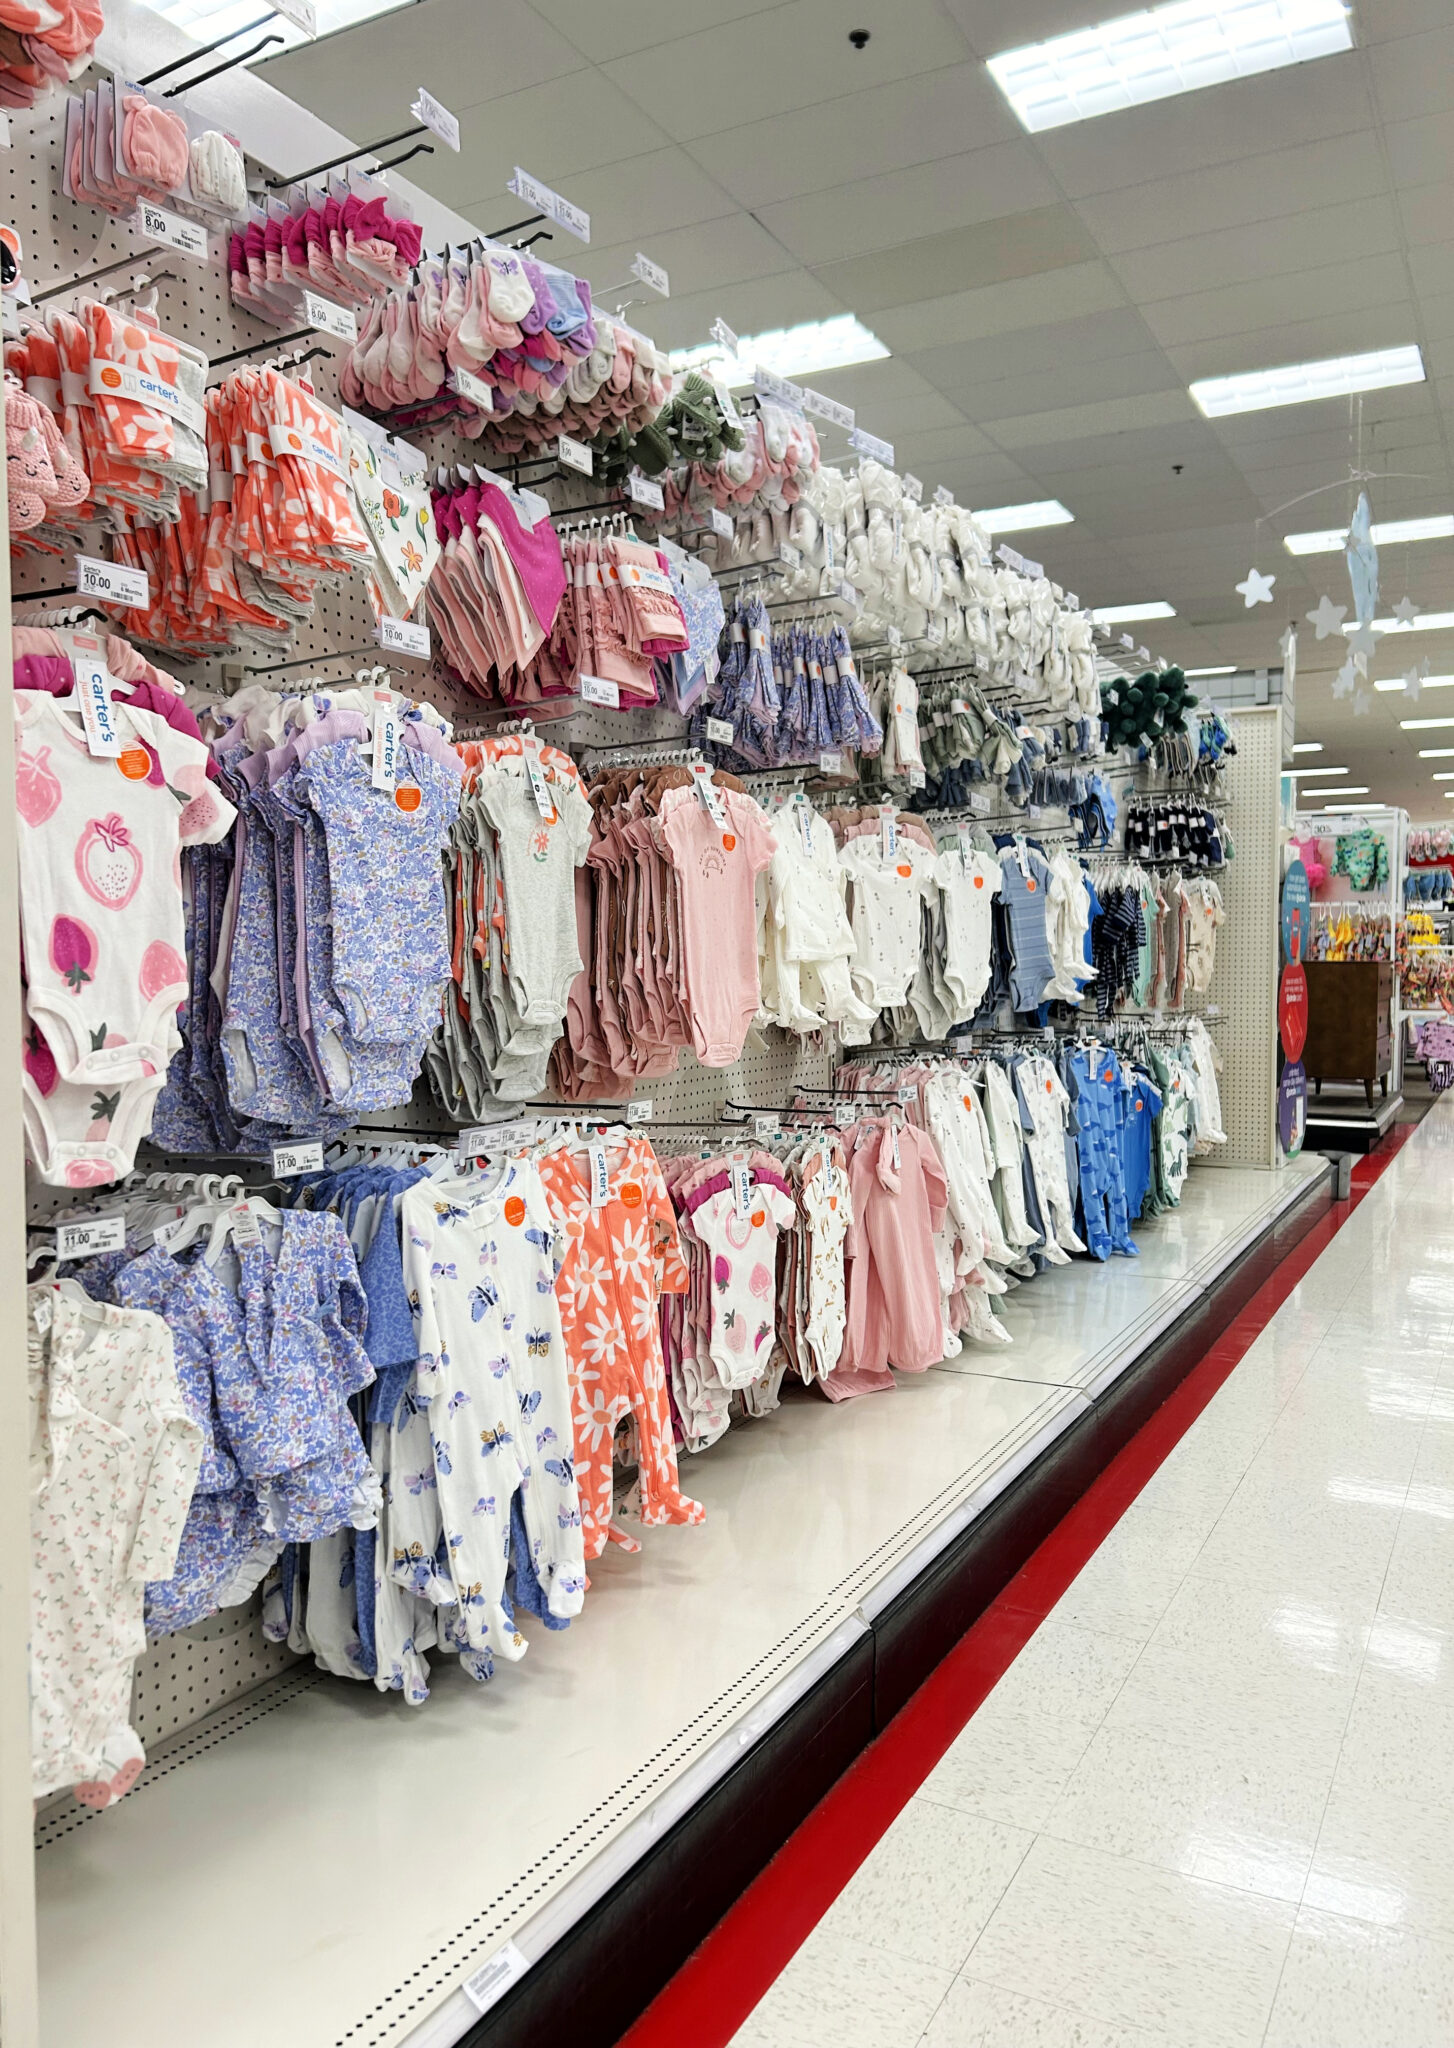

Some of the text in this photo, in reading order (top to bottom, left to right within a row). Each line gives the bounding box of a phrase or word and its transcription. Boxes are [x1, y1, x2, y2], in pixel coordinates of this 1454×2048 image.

[145, 215, 166, 232] 8.00
[311, 308, 327, 322] 8.00
[140, 379, 179, 405] carter's
[312, 444, 338, 466] carter's
[380, 444, 400, 462] carter's
[84, 573, 111, 590] 10.00
[384, 629, 403, 641] 10.00
[584, 685, 598, 695] 10.00
[80, 681, 96, 733] just one you
[91, 673, 116, 743] carter's
[384, 722, 395, 778] carter's
[803, 813, 812, 848] carter's
[888, 825, 896, 857] carter's
[277, 1158, 297, 1169] 11.00
[597, 1153, 607, 1198] carter's
[825, 1154, 833, 1189] carter's
[741, 1172, 751, 1211] carter's
[65, 1233, 90, 1246] 11.00
